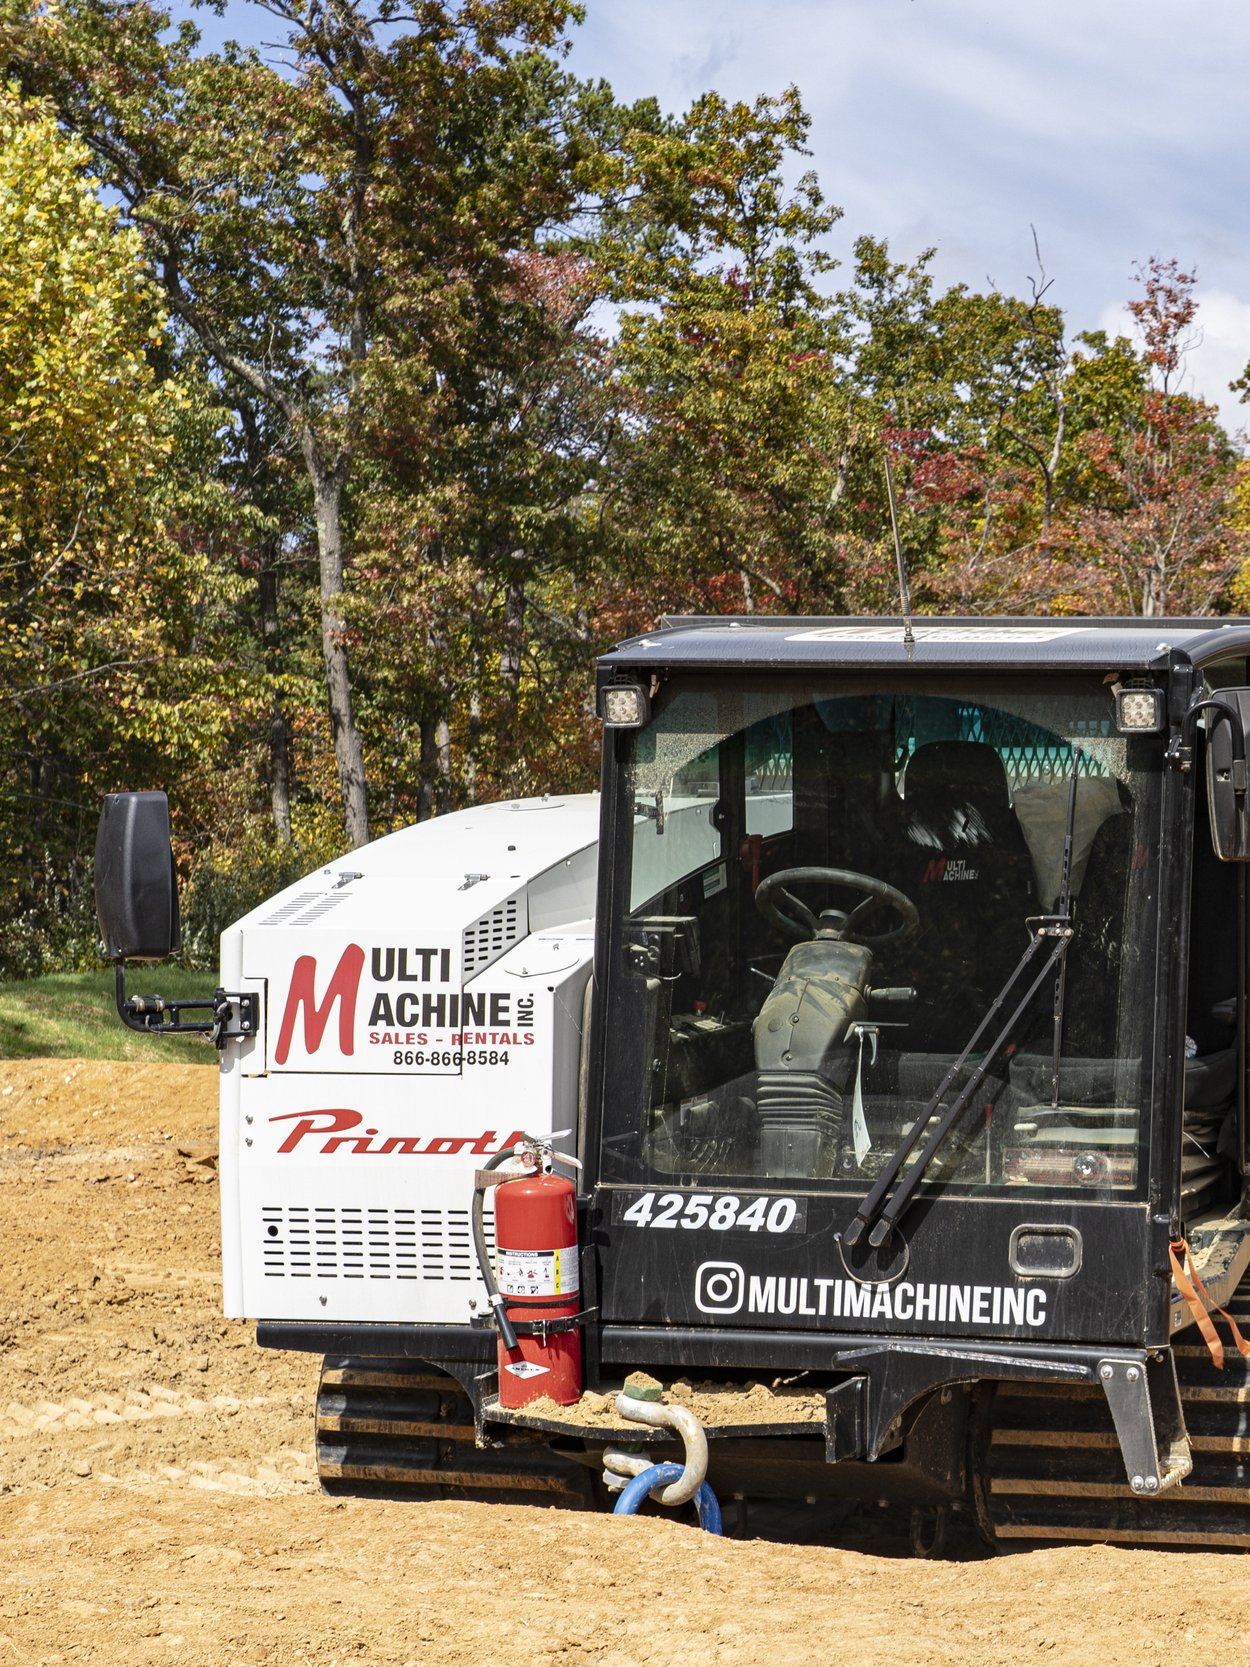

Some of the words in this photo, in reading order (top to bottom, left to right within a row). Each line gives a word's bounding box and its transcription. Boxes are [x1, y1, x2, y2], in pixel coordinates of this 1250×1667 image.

[517, 993, 534, 1027] INC.
[369, 1031, 428, 1045] SALES
[451, 1032, 535, 1046] RENTALS
[393, 1050, 510, 1067] 866-866-8584
[623, 1192, 797, 1233] 425840
[748, 1275, 1047, 1326] MULTIMACHINEINC
